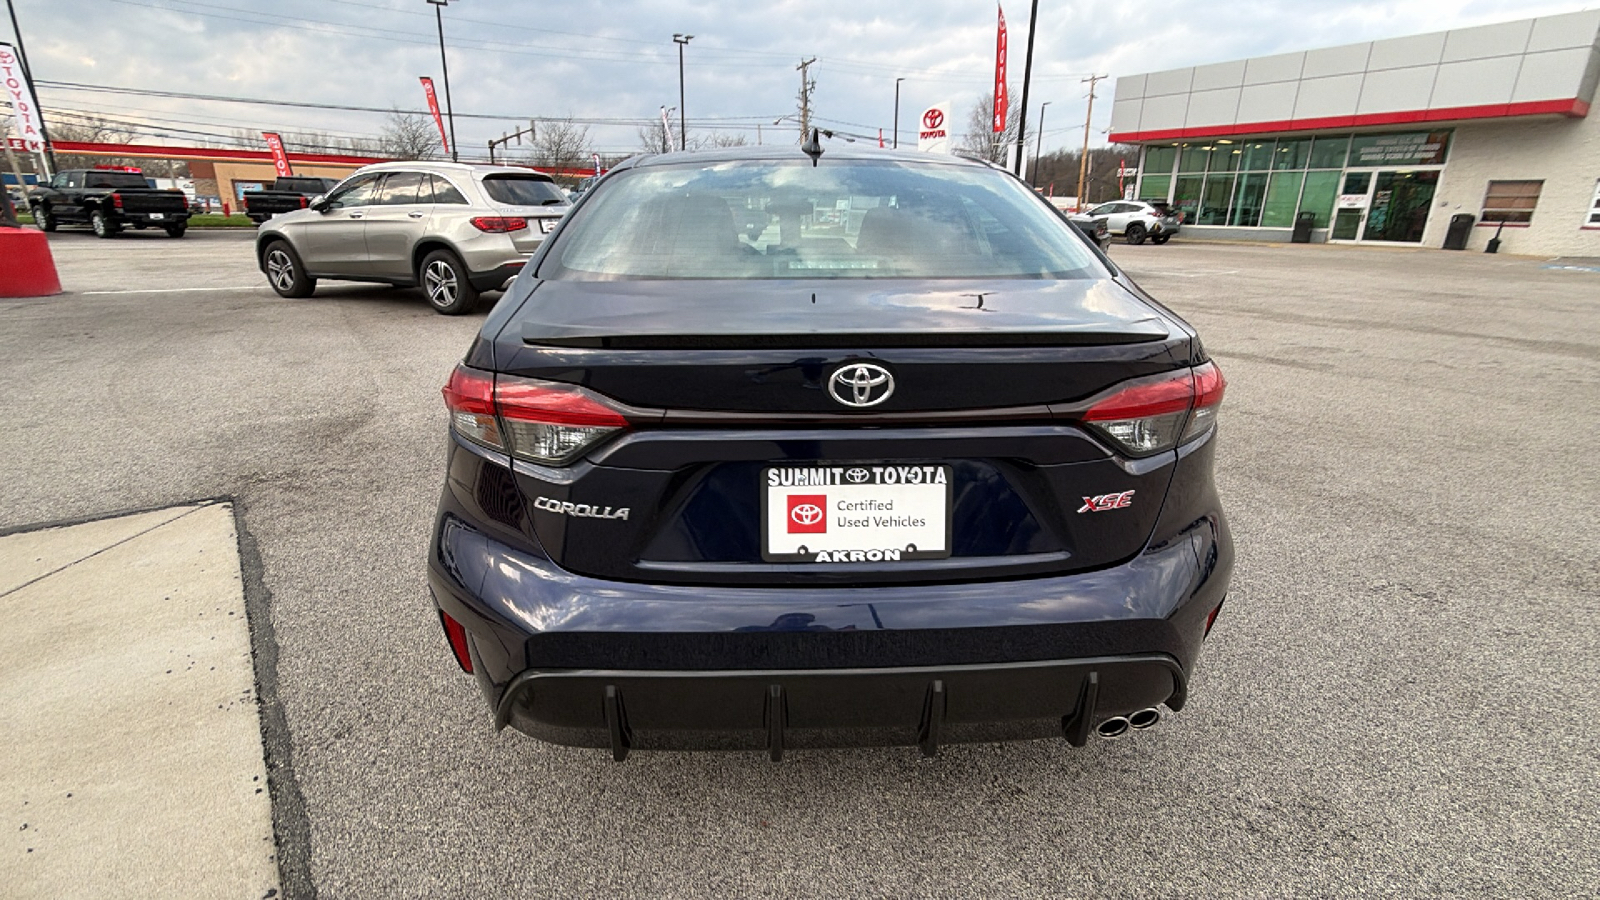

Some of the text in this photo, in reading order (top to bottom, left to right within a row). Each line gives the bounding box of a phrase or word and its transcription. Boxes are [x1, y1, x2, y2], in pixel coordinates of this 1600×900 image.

[994, 32, 1006, 127] TOYOTA
[2, 66, 37, 135] TOYOTA
[920, 129, 946, 140] TOYOTA
[767, 466, 947, 486] SUMMIT TOYOTA
[533, 496, 630, 521] COROLLA
[837, 499, 894, 511] Certified
[1076, 490, 1136, 513] XSE
[837, 515, 926, 528] Used Vehicles
[815, 549, 901, 563] AKRON
